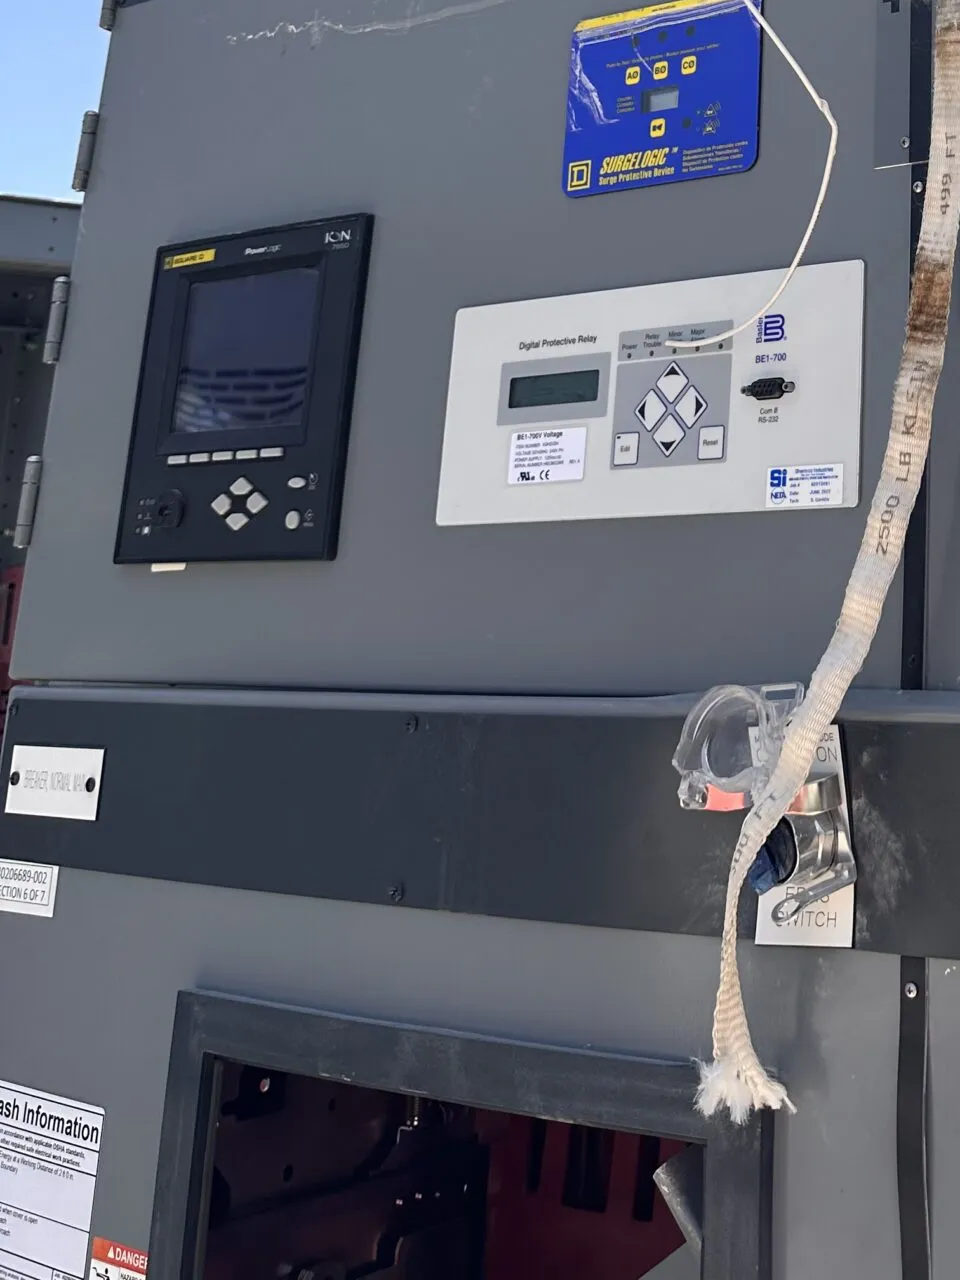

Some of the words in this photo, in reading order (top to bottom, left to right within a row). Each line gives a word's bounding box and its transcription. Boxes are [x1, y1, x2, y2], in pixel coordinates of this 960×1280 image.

[945, 131, 957, 159] FT
[600, 147, 670, 175] SURGELOGIC
[599, 175, 618, 186] Surge
[618, 169, 652, 183] Protective
[653, 166, 675, 178] Device
[324, 230, 352, 245] ION
[174, 254, 198, 265] SQUARE
[519, 340, 541, 351] Digital
[542, 337, 576, 348] Protective
[577, 335, 597, 344] Relay
[755, 352, 787, 364] BE1-700
[543, 431, 563, 439] Voltage
[770, 468, 787, 487] Si
[876, 494, 900, 557] 2500
[895, 451, 912, 483] LB
[816, 746, 838, 763] ON
[0, 866, 48, 885] 0206689-002
[29, 888, 39, 901] OF
[22, 1101, 99, 1145] Information
[52, 1142, 65, 1153] OSHA
